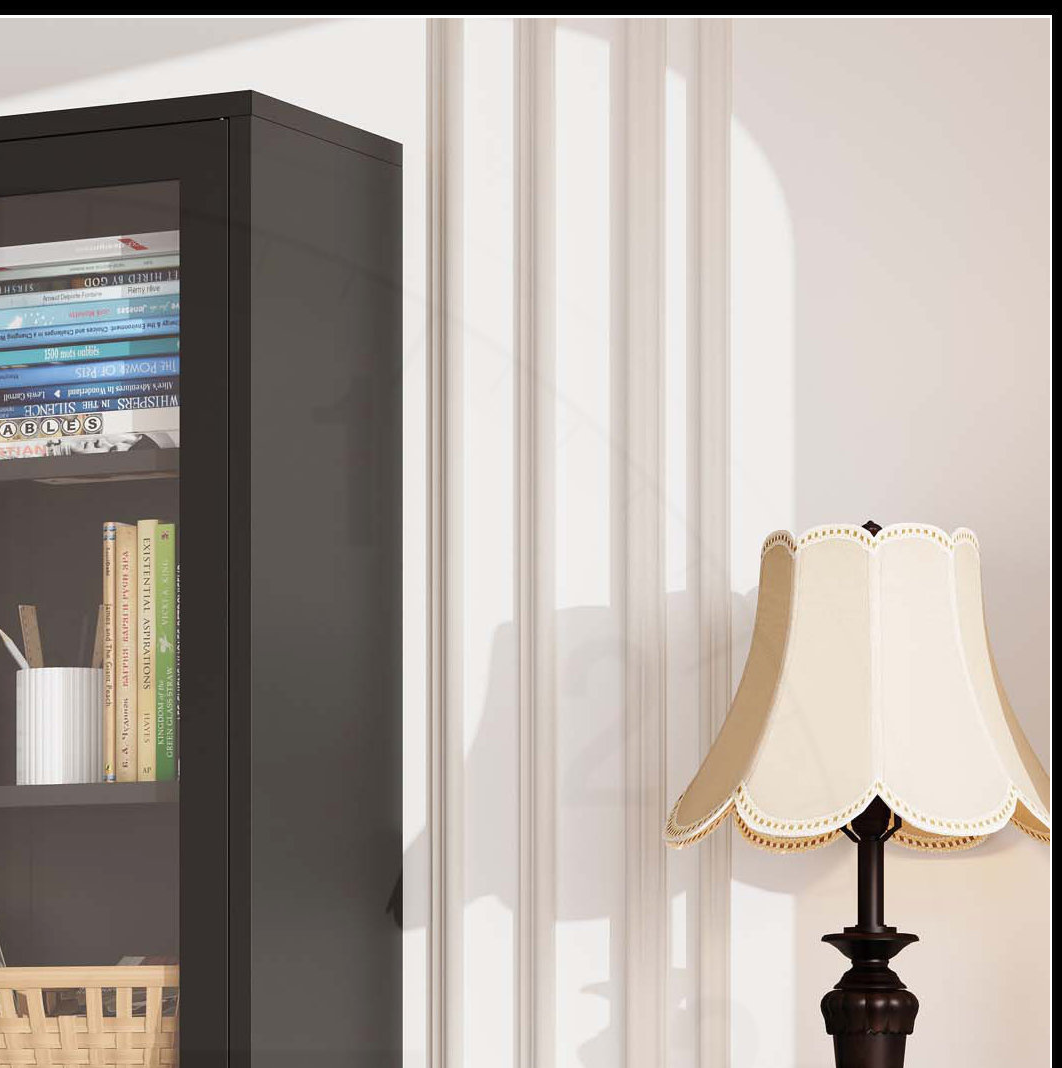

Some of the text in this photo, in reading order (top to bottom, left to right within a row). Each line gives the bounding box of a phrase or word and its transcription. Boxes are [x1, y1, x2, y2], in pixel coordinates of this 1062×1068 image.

[84, 277, 108, 288] GOD
[3, 391, 46, 402] Lewis Carroll
[67, 386, 106, 398] Wonderland
[24, 401, 76, 417] SILENCE
[82, 400, 99, 409] THE
[101, 400, 111, 408] IN
[117, 395, 179, 410] WHISPERS
[143, 537, 151, 611] EXISTENTIAL
[143, 617, 151, 690] ASPIRATIONS
[157, 702, 165, 746] KINGDOM
